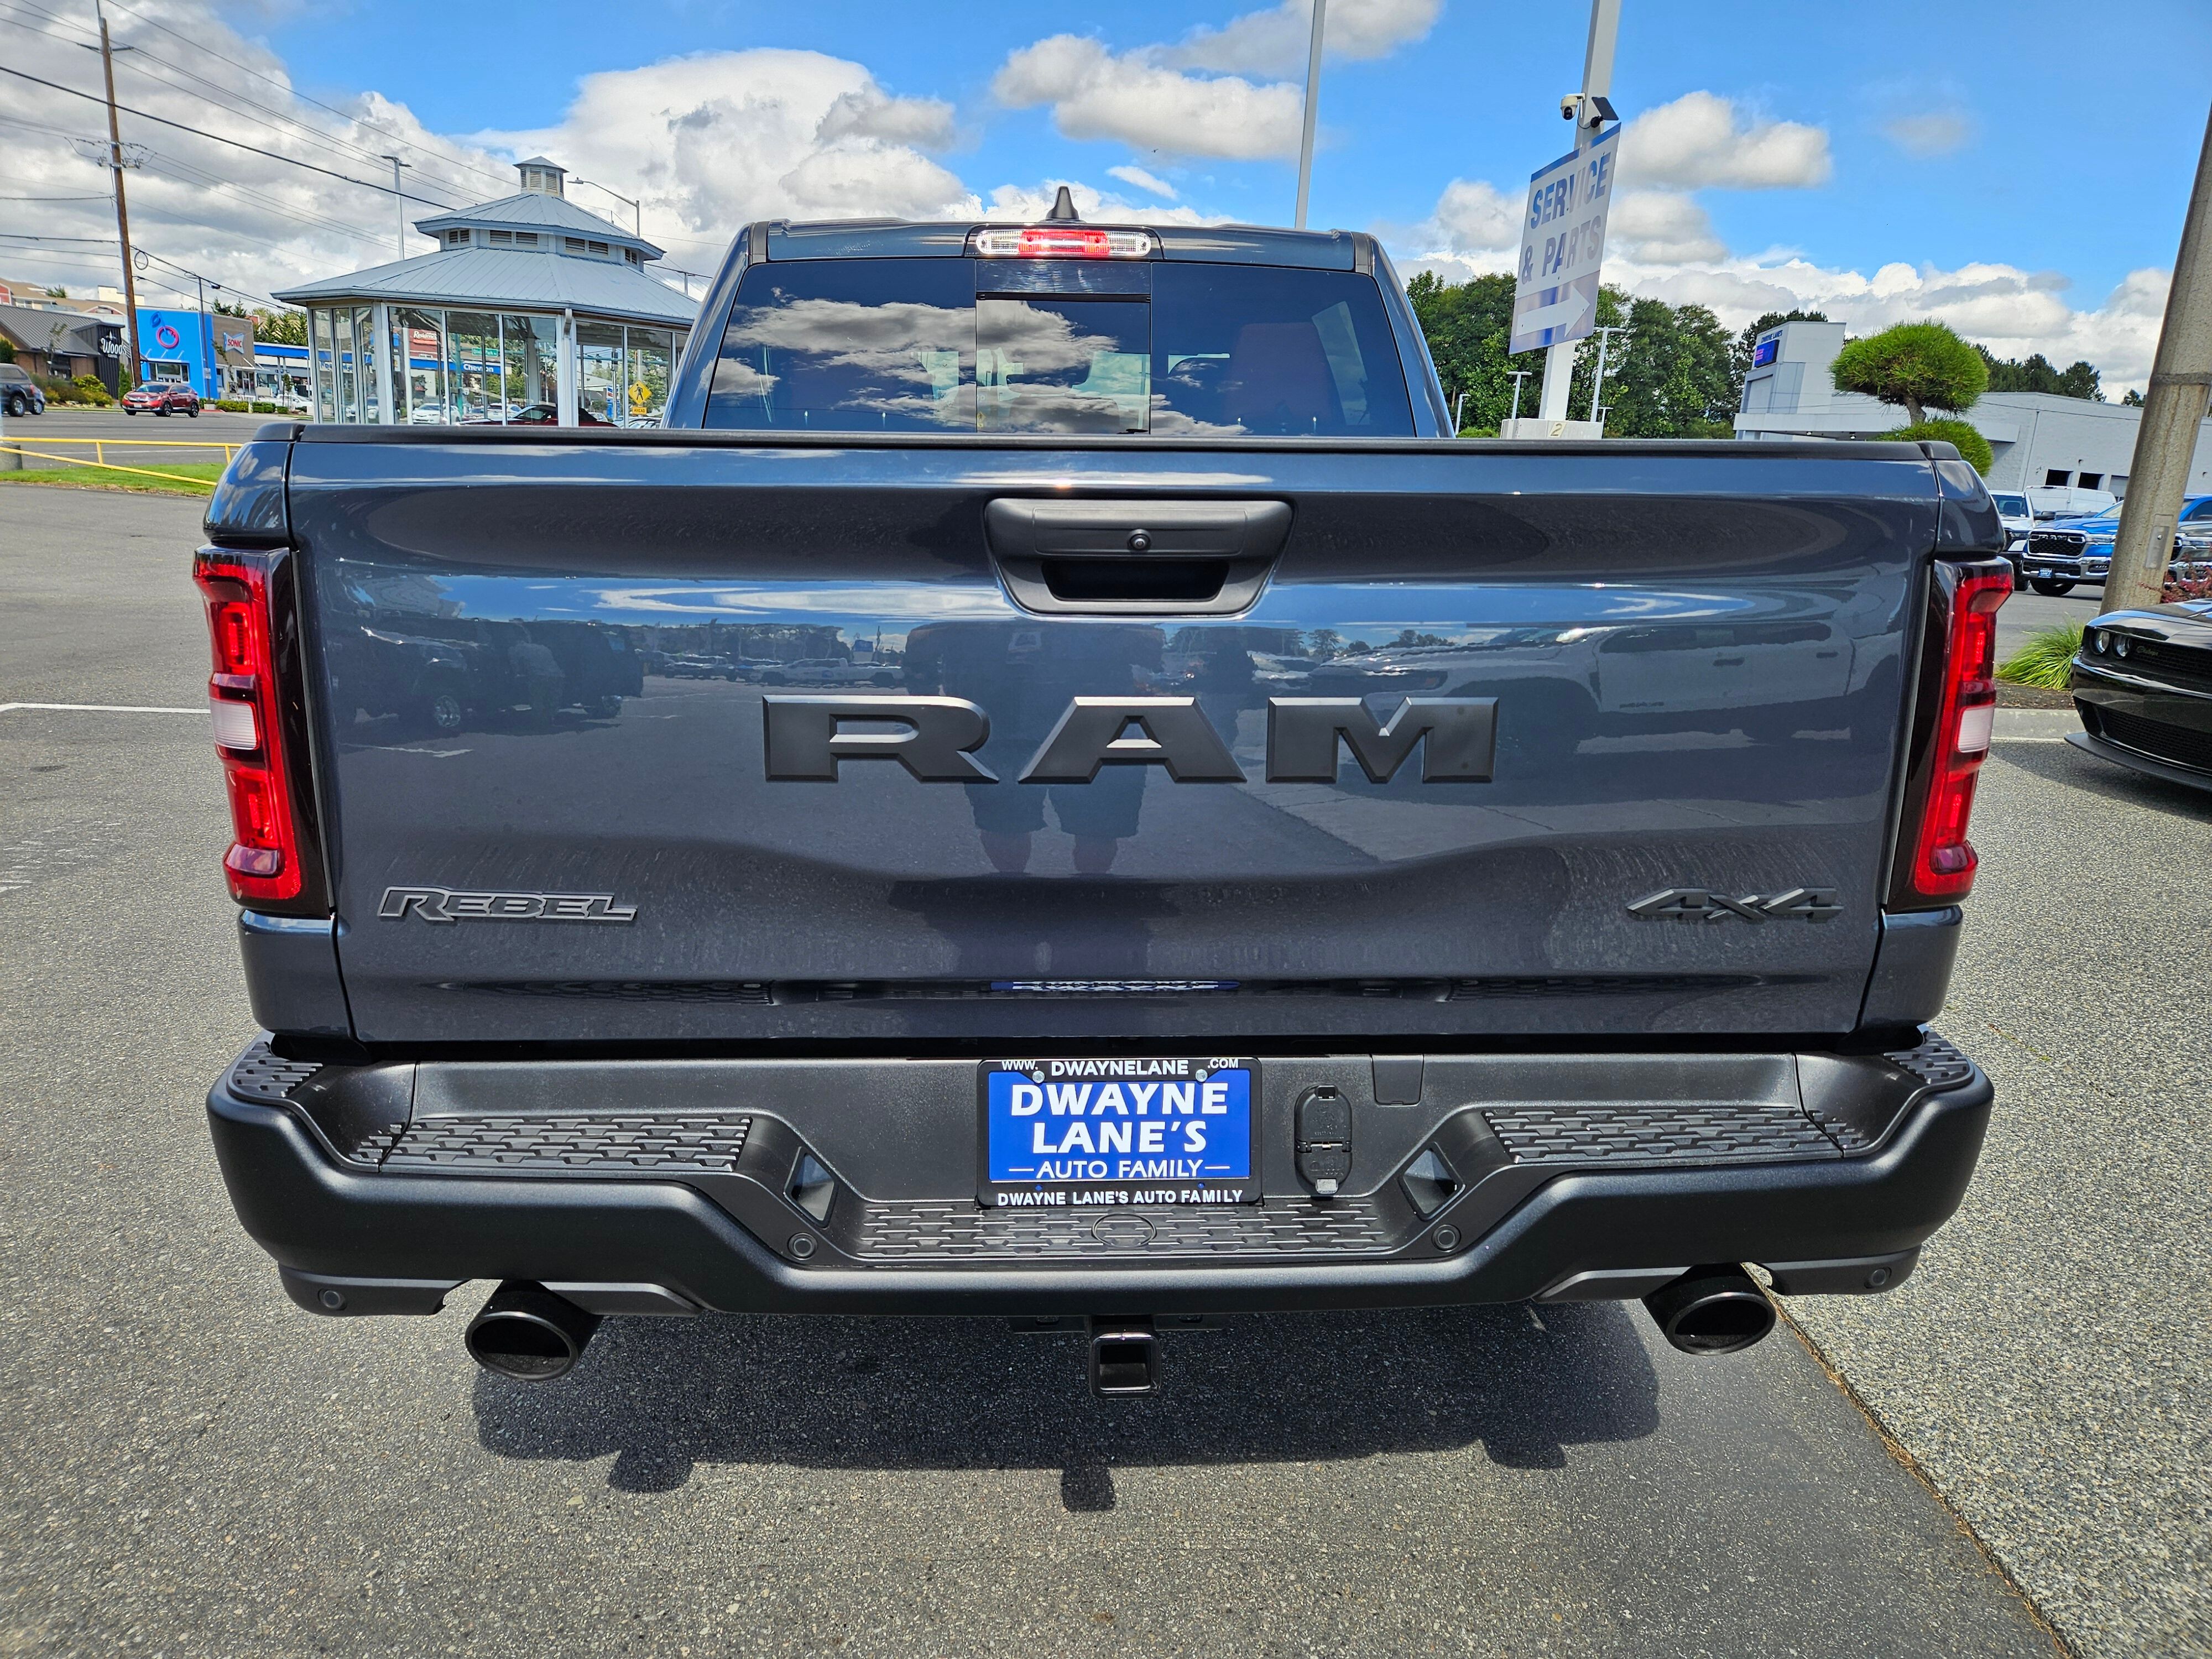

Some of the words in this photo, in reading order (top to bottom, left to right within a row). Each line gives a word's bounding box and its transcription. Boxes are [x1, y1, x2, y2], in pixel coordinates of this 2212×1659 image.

[1531, 152, 1611, 229] SERVICE
[1522, 245, 1533, 284] &
[1542, 215, 1601, 276] PARTS
[101, 337, 127, 354] Woods
[227, 339, 242, 347] SONIC
[1551, 423, 1562, 436] 2
[763, 695, 1500, 784] RAM
[377, 886, 638, 922] REBEL
[1001, 1060, 1038, 1071] WWW.
[1051, 1060, 1189, 1076] DWAYNELANE
[1207, 1058, 1239, 1068] .COM
[1011, 1083, 1229, 1116] DWAYNE
[1032, 1120, 1207, 1154] LANE'S
[1036, 1161, 1108, 1178] AUTO
[1119, 1159, 1203, 1178] FAMILY
[997, 1193, 1066, 1206] DWAYNE
[1073, 1191, 1129, 1204] LANE'S
[1133, 1190, 1177, 1204] AUTO
[1181, 1189, 1243, 1203] FAMILY
